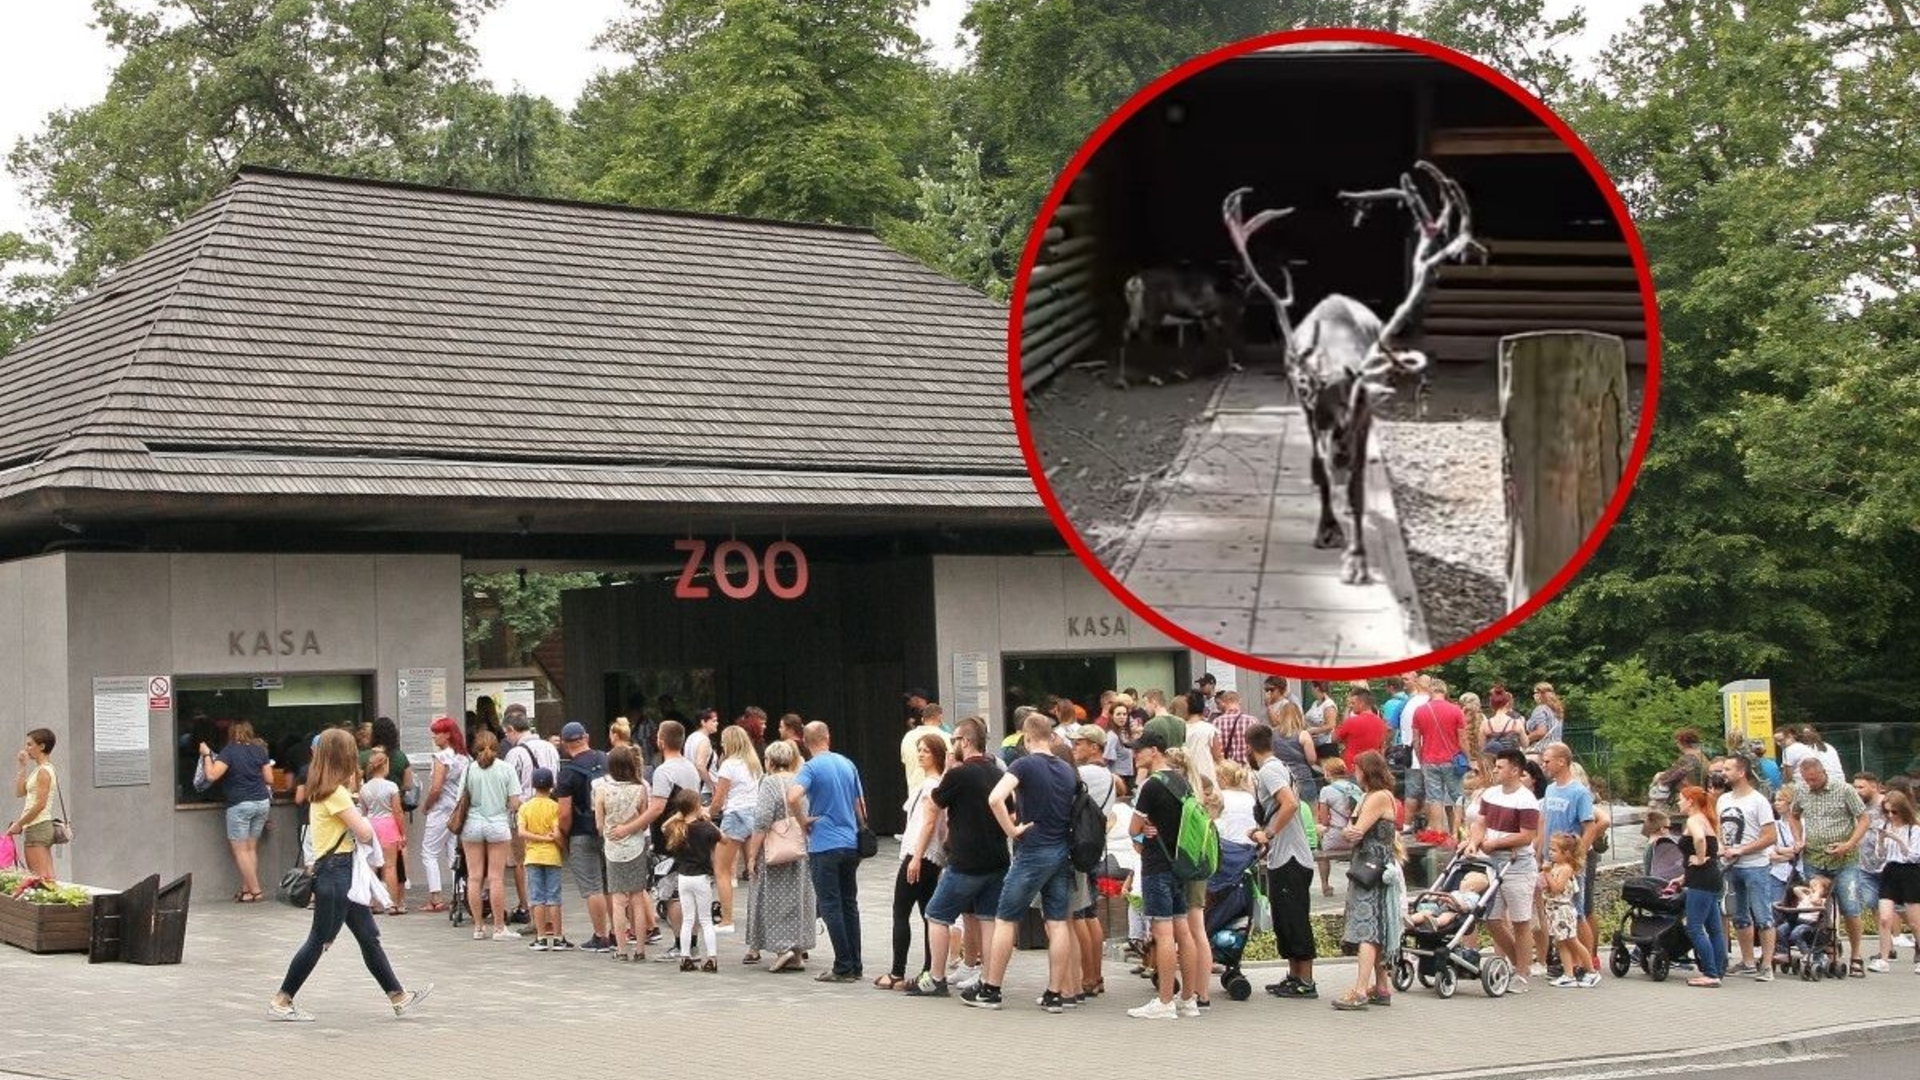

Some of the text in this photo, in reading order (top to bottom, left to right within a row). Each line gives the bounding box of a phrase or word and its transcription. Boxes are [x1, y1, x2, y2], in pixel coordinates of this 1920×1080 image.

[674, 539, 809, 599] ZOO
[1067, 615, 1127, 637] KASA
[228, 629, 322, 656] KASA
